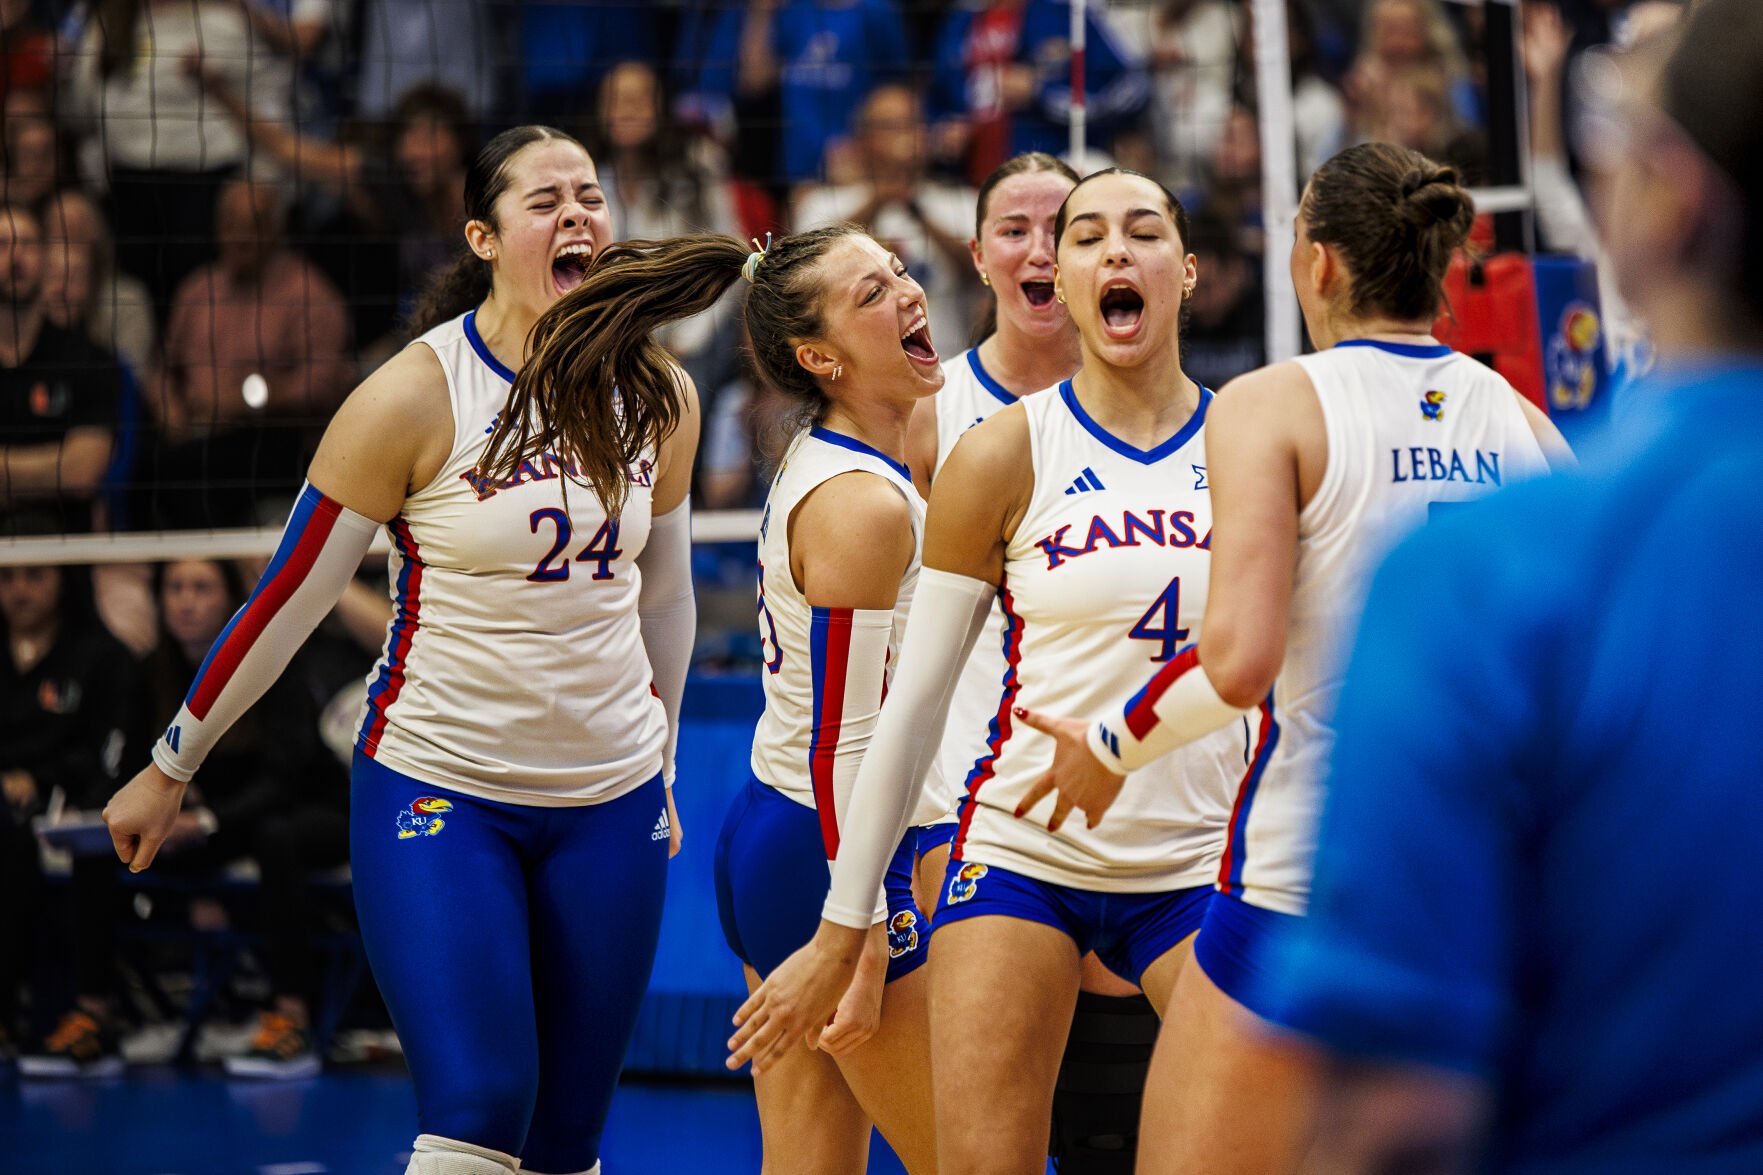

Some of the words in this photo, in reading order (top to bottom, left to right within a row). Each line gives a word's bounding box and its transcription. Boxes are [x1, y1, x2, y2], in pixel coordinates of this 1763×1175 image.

[1391, 446, 1501, 487] LEBAN
[526, 507, 623, 582] 24
[1128, 576, 1190, 662] 4
[411, 816, 427, 825] KU
